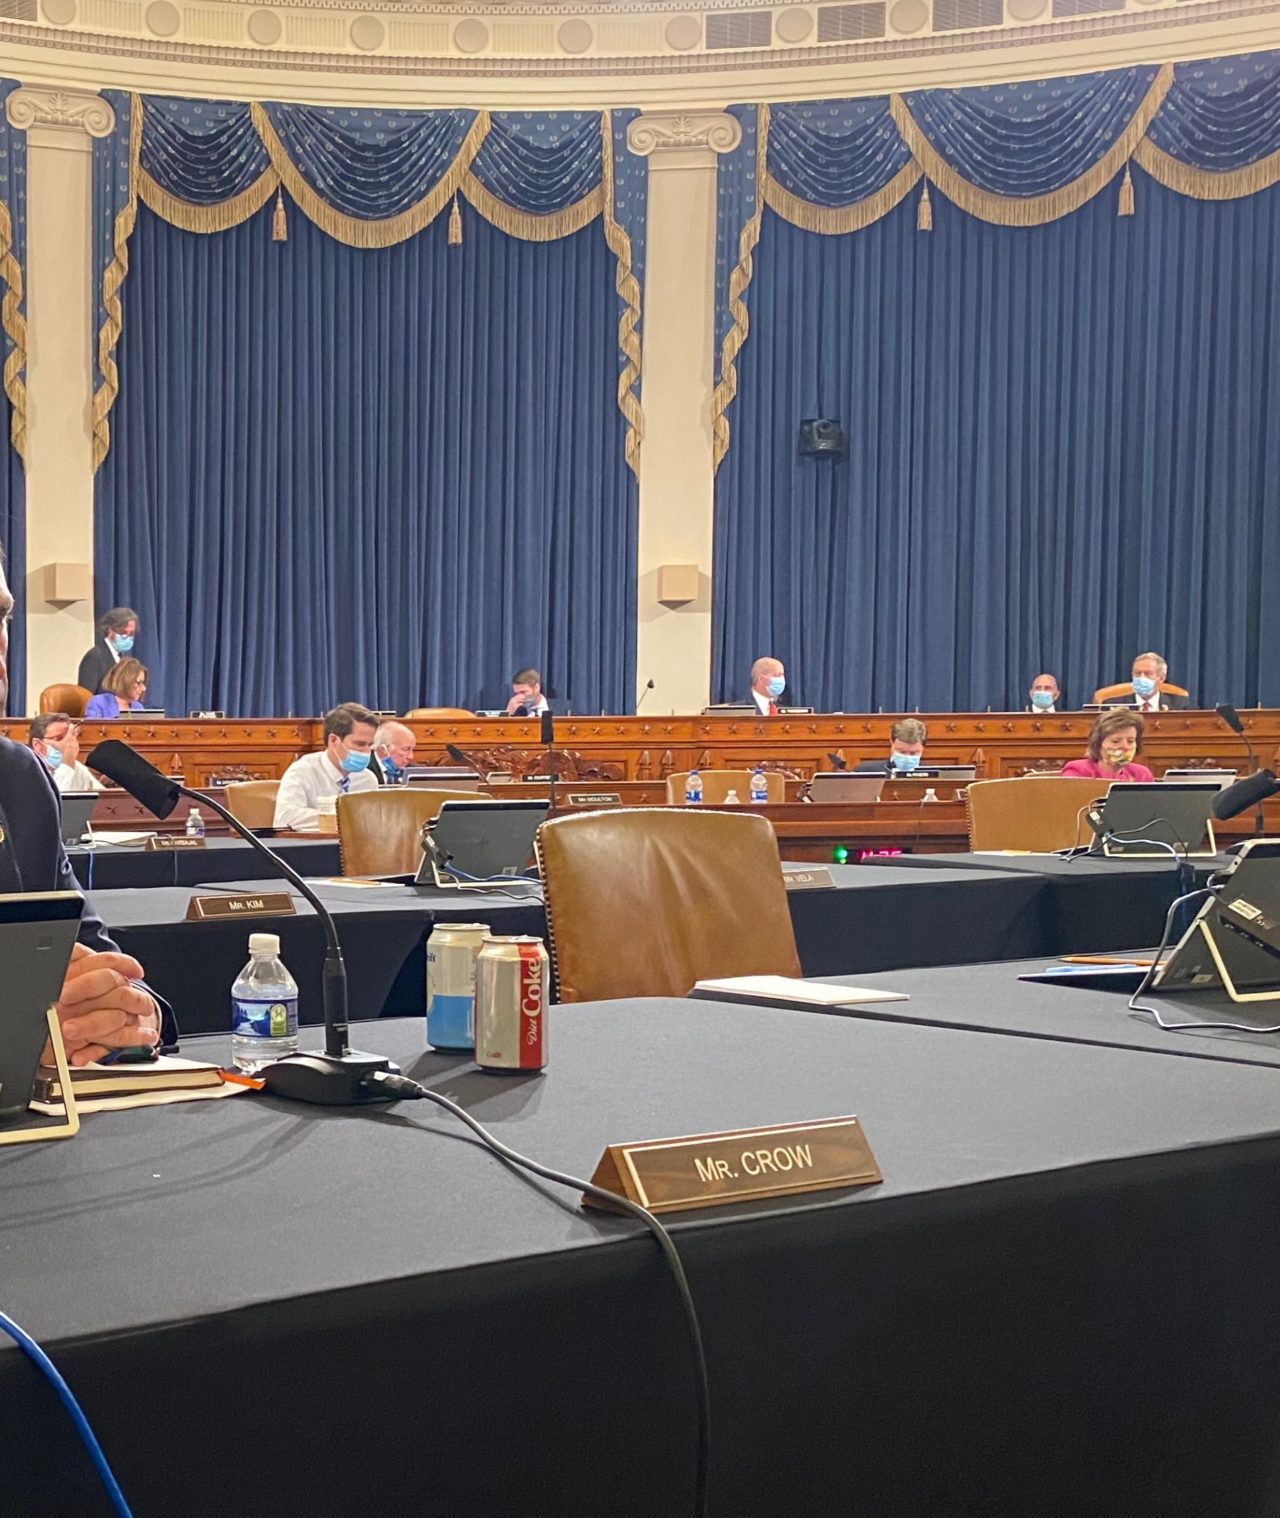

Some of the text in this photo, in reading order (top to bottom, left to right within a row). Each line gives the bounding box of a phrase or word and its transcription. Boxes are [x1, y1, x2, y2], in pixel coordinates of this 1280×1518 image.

[246, 899, 264, 909] KIM
[521, 957, 542, 1018] Coke
[740, 1144, 814, 1175] CROW
